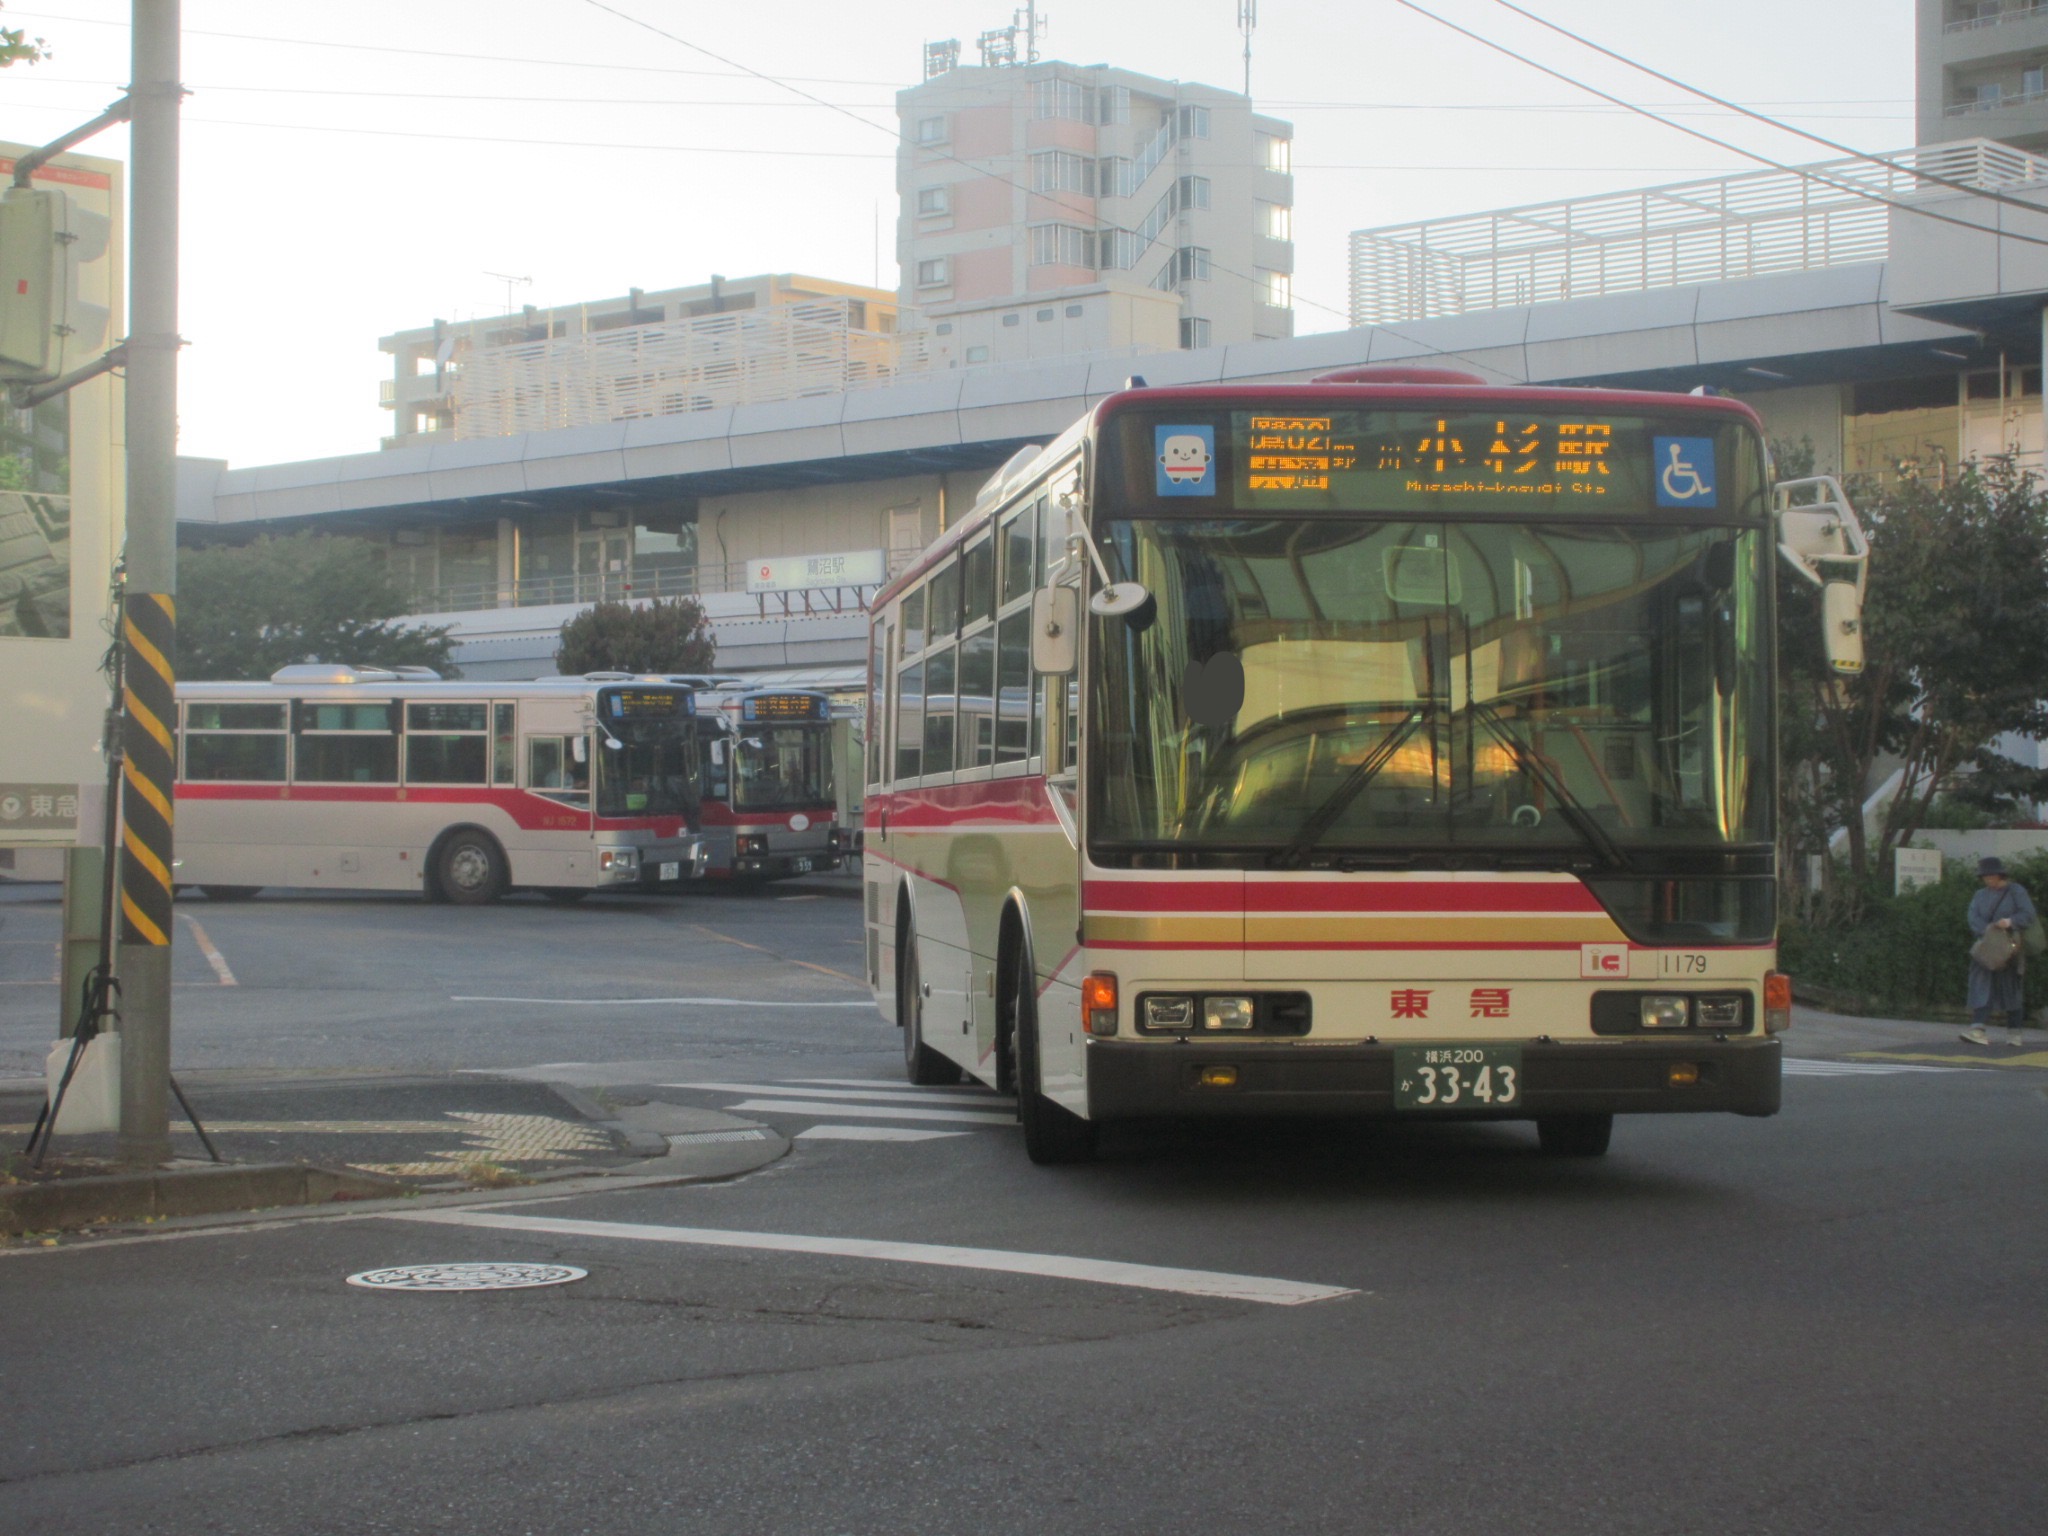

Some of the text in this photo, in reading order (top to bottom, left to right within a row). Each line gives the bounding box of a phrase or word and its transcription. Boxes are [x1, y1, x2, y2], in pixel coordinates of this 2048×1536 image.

[30, 794, 79, 818] 東急
[1664, 954, 1707, 973] 1179
[1400, 1065, 1517, 1104] か 33-43
